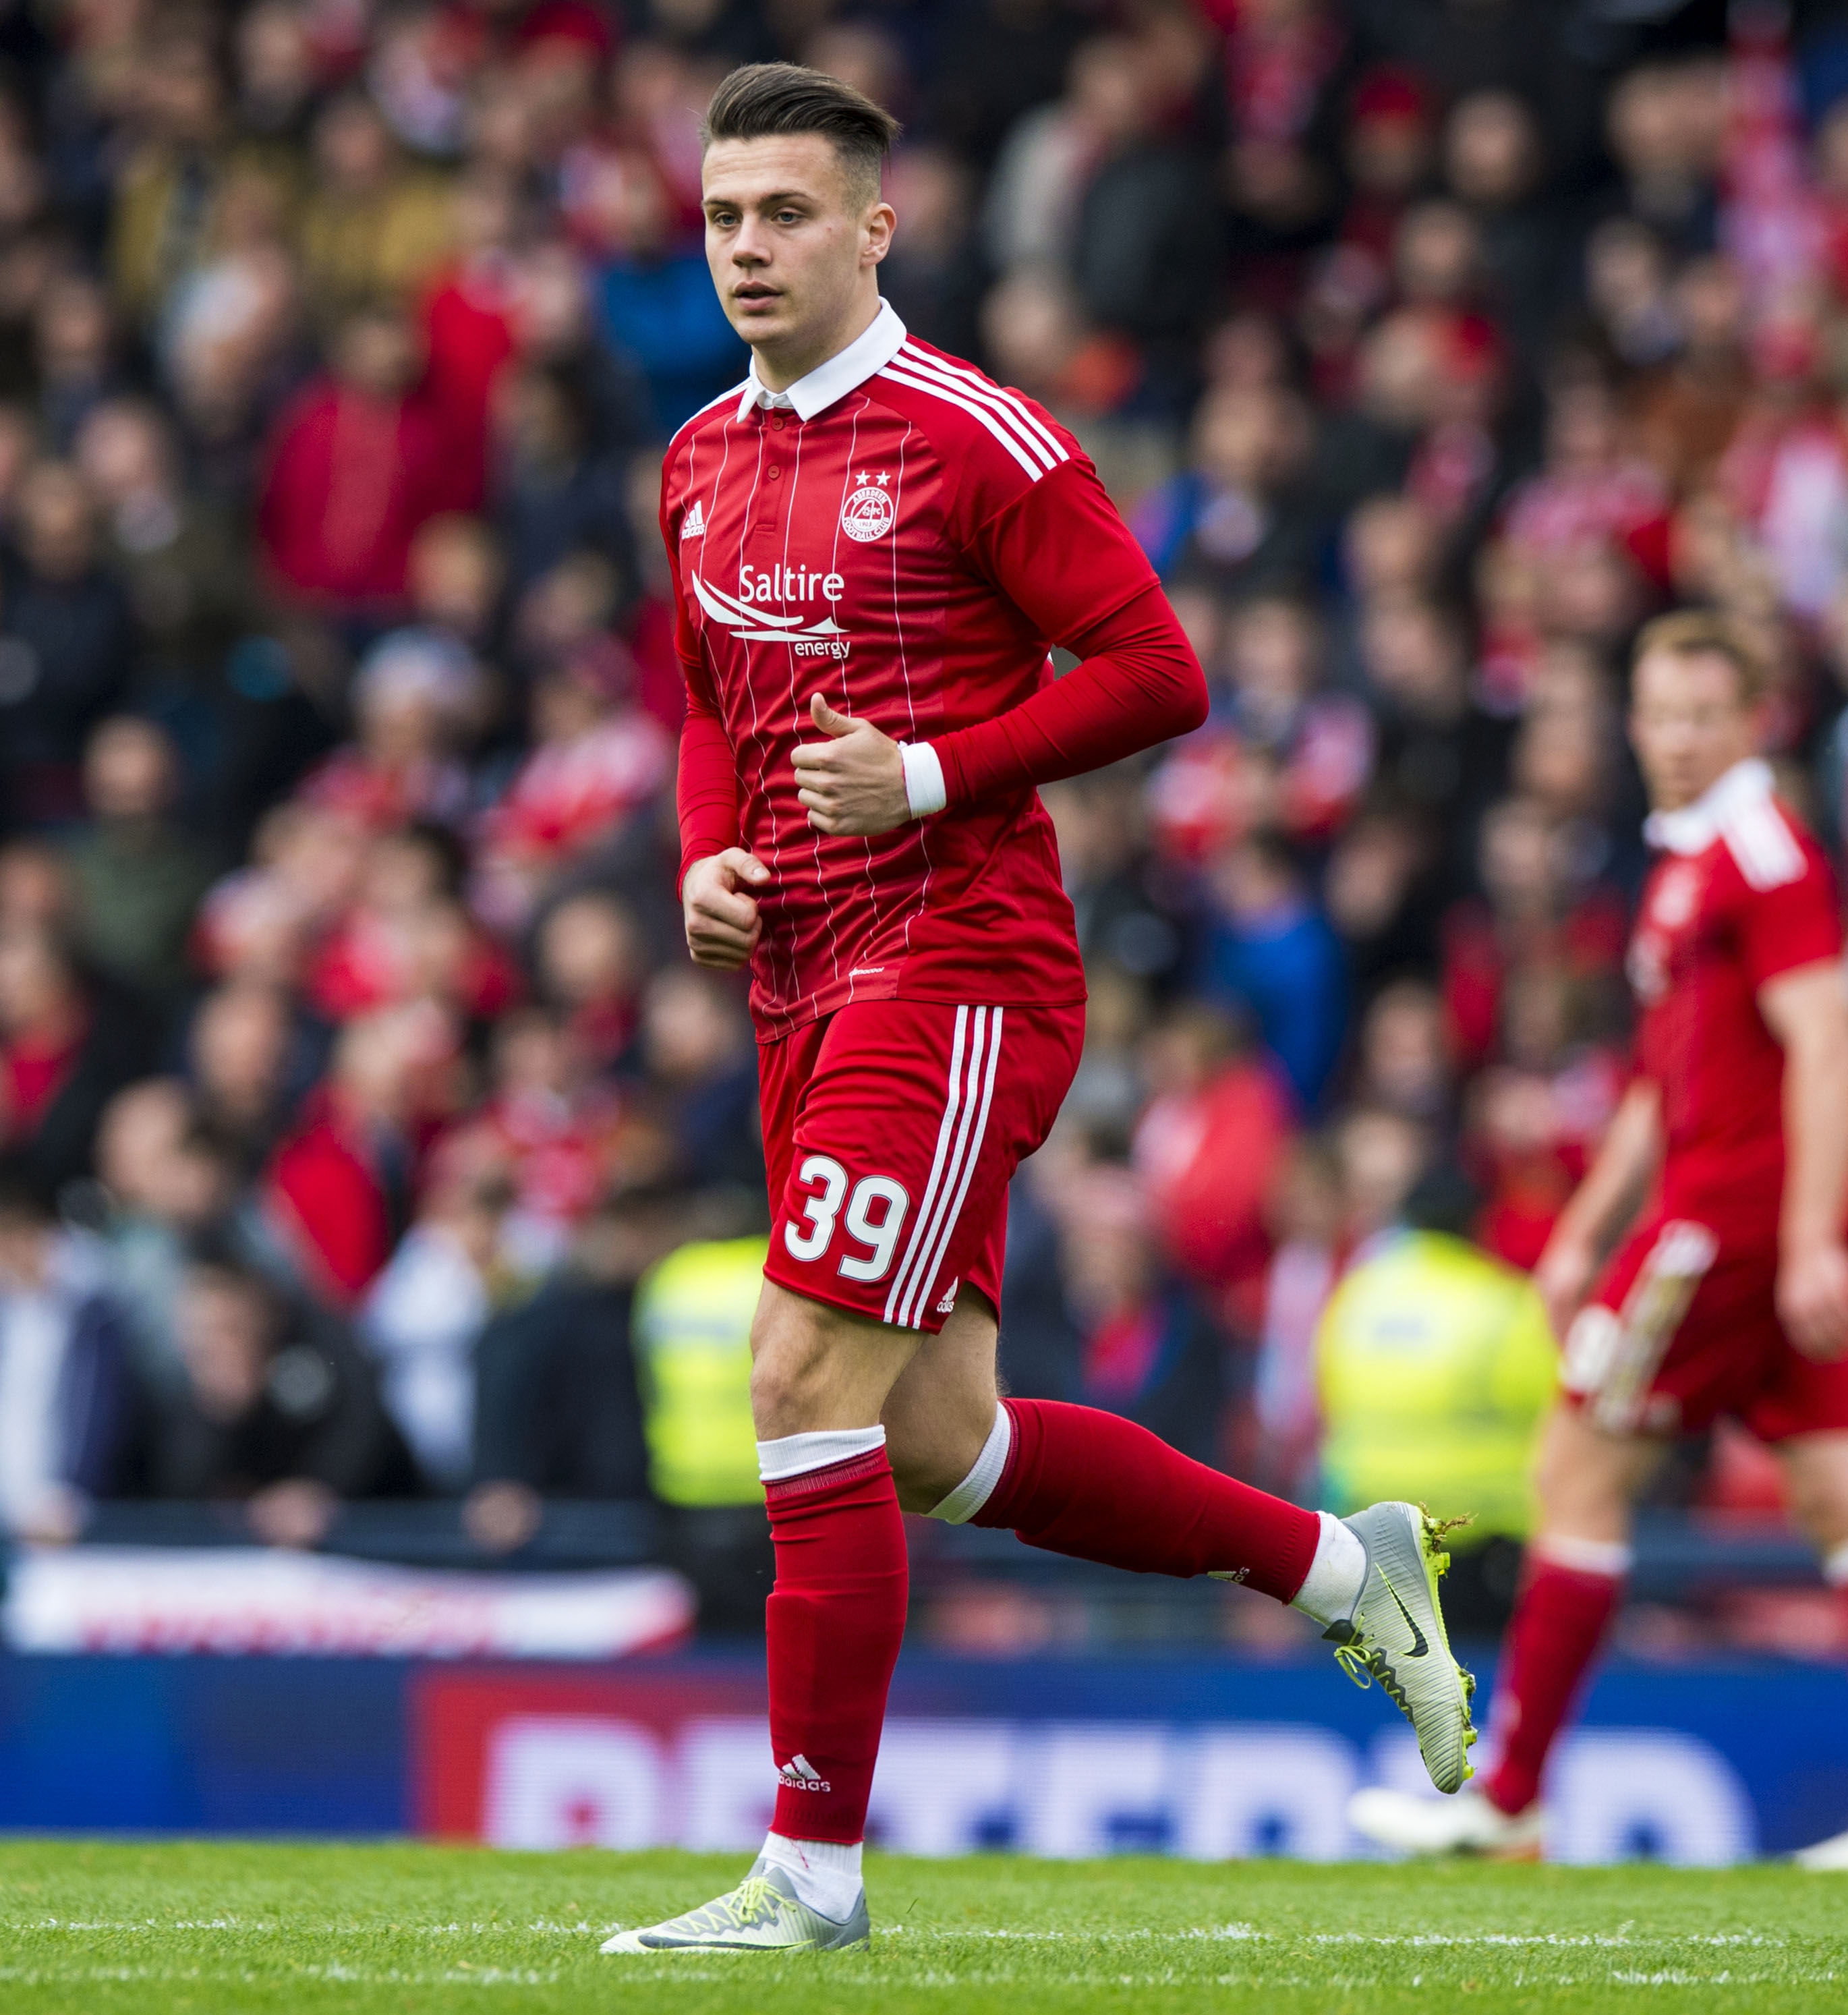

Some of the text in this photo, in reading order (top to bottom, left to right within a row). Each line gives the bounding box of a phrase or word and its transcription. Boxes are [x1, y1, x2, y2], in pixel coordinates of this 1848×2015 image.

[740, 563, 844, 602] Saltire
[795, 640, 851, 659] energy
[784, 1154, 910, 1282] 39
